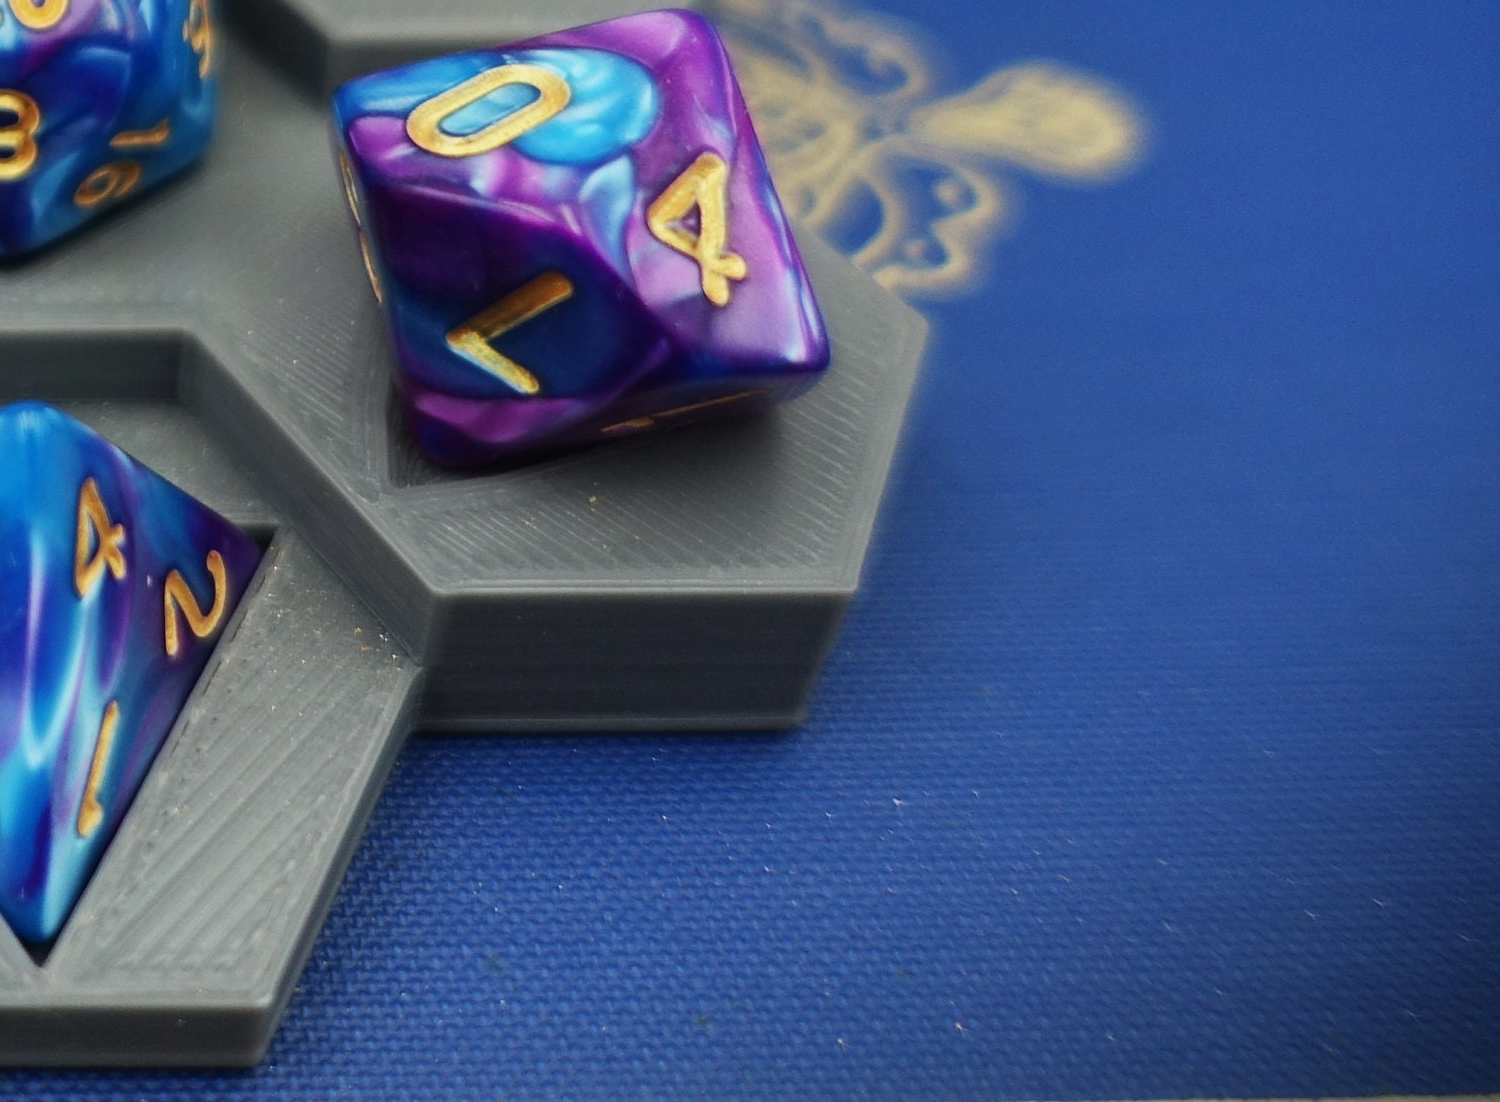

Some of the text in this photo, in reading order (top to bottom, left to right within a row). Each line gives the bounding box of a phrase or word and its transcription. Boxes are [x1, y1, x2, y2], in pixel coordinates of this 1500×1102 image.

[406, 64, 571, 158] 0
[647, 151, 748, 309] 4
[75, 476, 125, 598] 4
[164, 549, 226, 656] 2
[78, 700, 119, 838] 1
